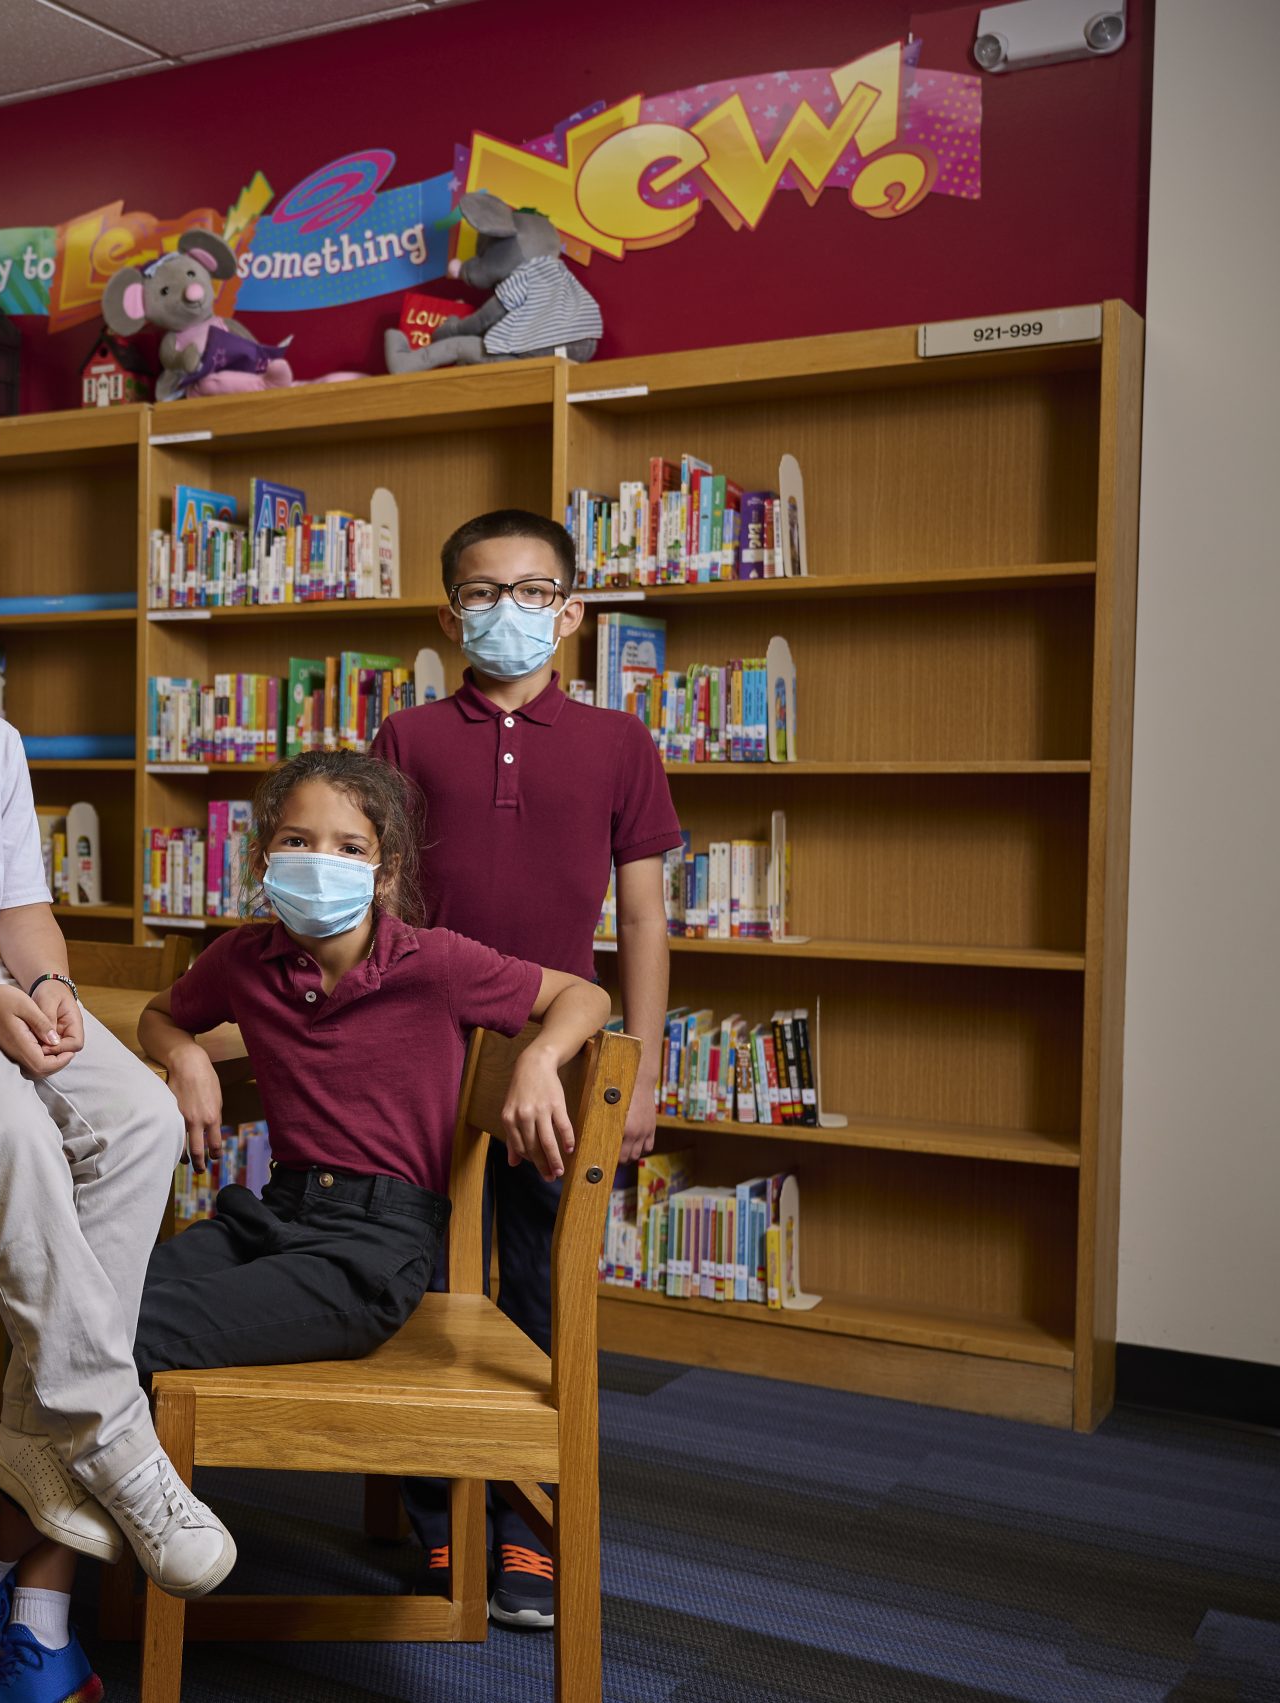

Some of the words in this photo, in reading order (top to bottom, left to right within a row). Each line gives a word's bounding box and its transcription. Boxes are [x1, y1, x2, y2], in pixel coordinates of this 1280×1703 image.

[22, 246, 56, 281] to
[236, 223, 427, 280] something
[973, 321, 1043, 342] 921-999
